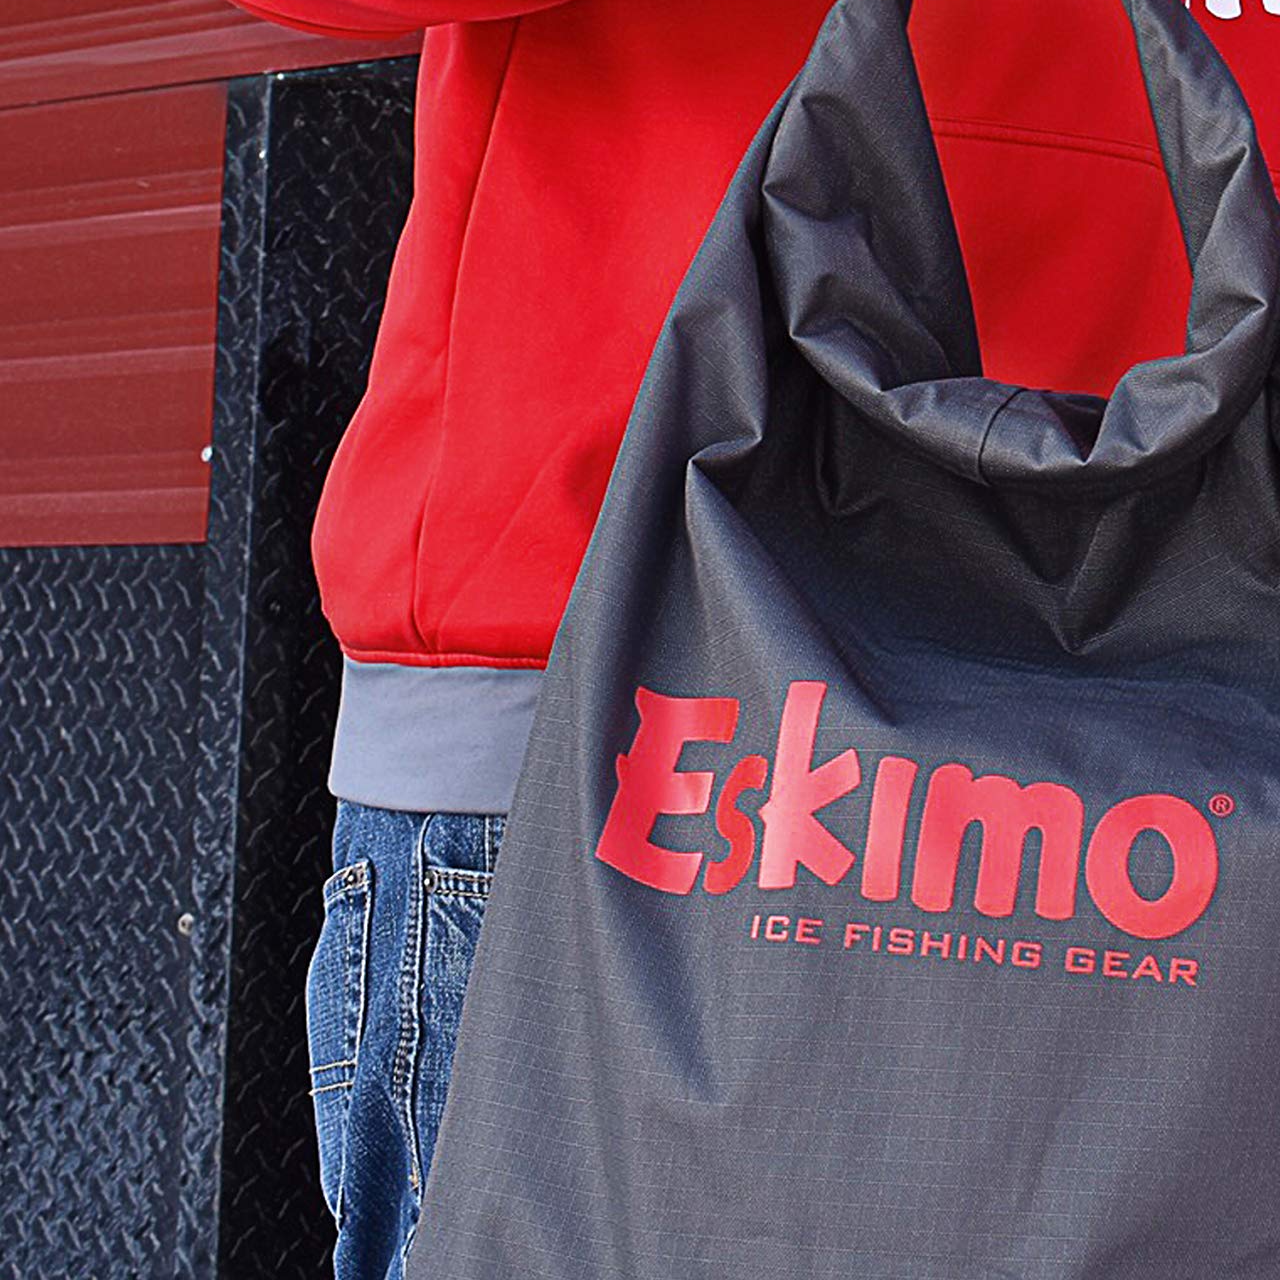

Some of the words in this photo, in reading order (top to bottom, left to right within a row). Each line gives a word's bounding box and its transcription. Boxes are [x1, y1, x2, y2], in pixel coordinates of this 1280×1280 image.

[750, 915, 824, 945] ICE
[844, 922, 1043, 970] FISHING
[1064, 946, 1200, 987] GEAR
